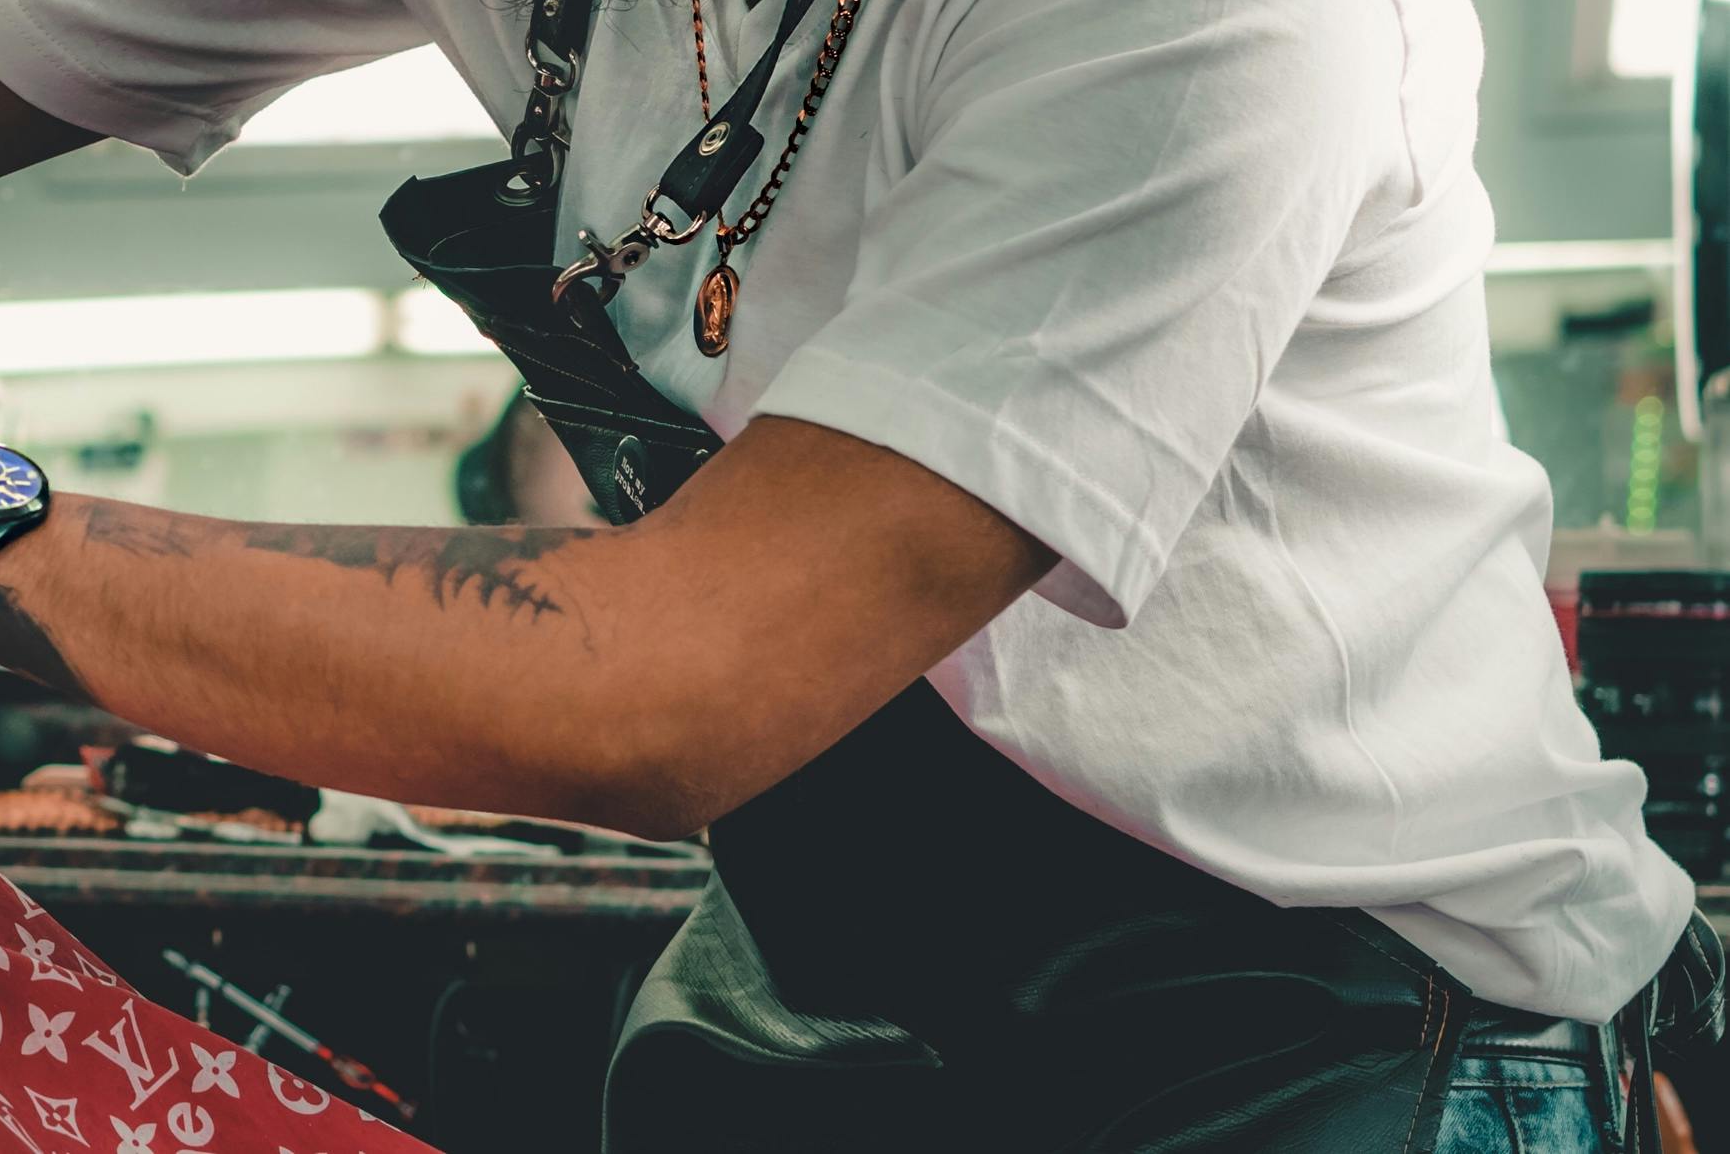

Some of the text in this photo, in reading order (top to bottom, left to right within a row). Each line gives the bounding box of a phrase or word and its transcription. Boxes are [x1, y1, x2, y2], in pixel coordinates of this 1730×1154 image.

[614, 469, 646, 515] problem.
[621, 456, 646, 496] Not my
